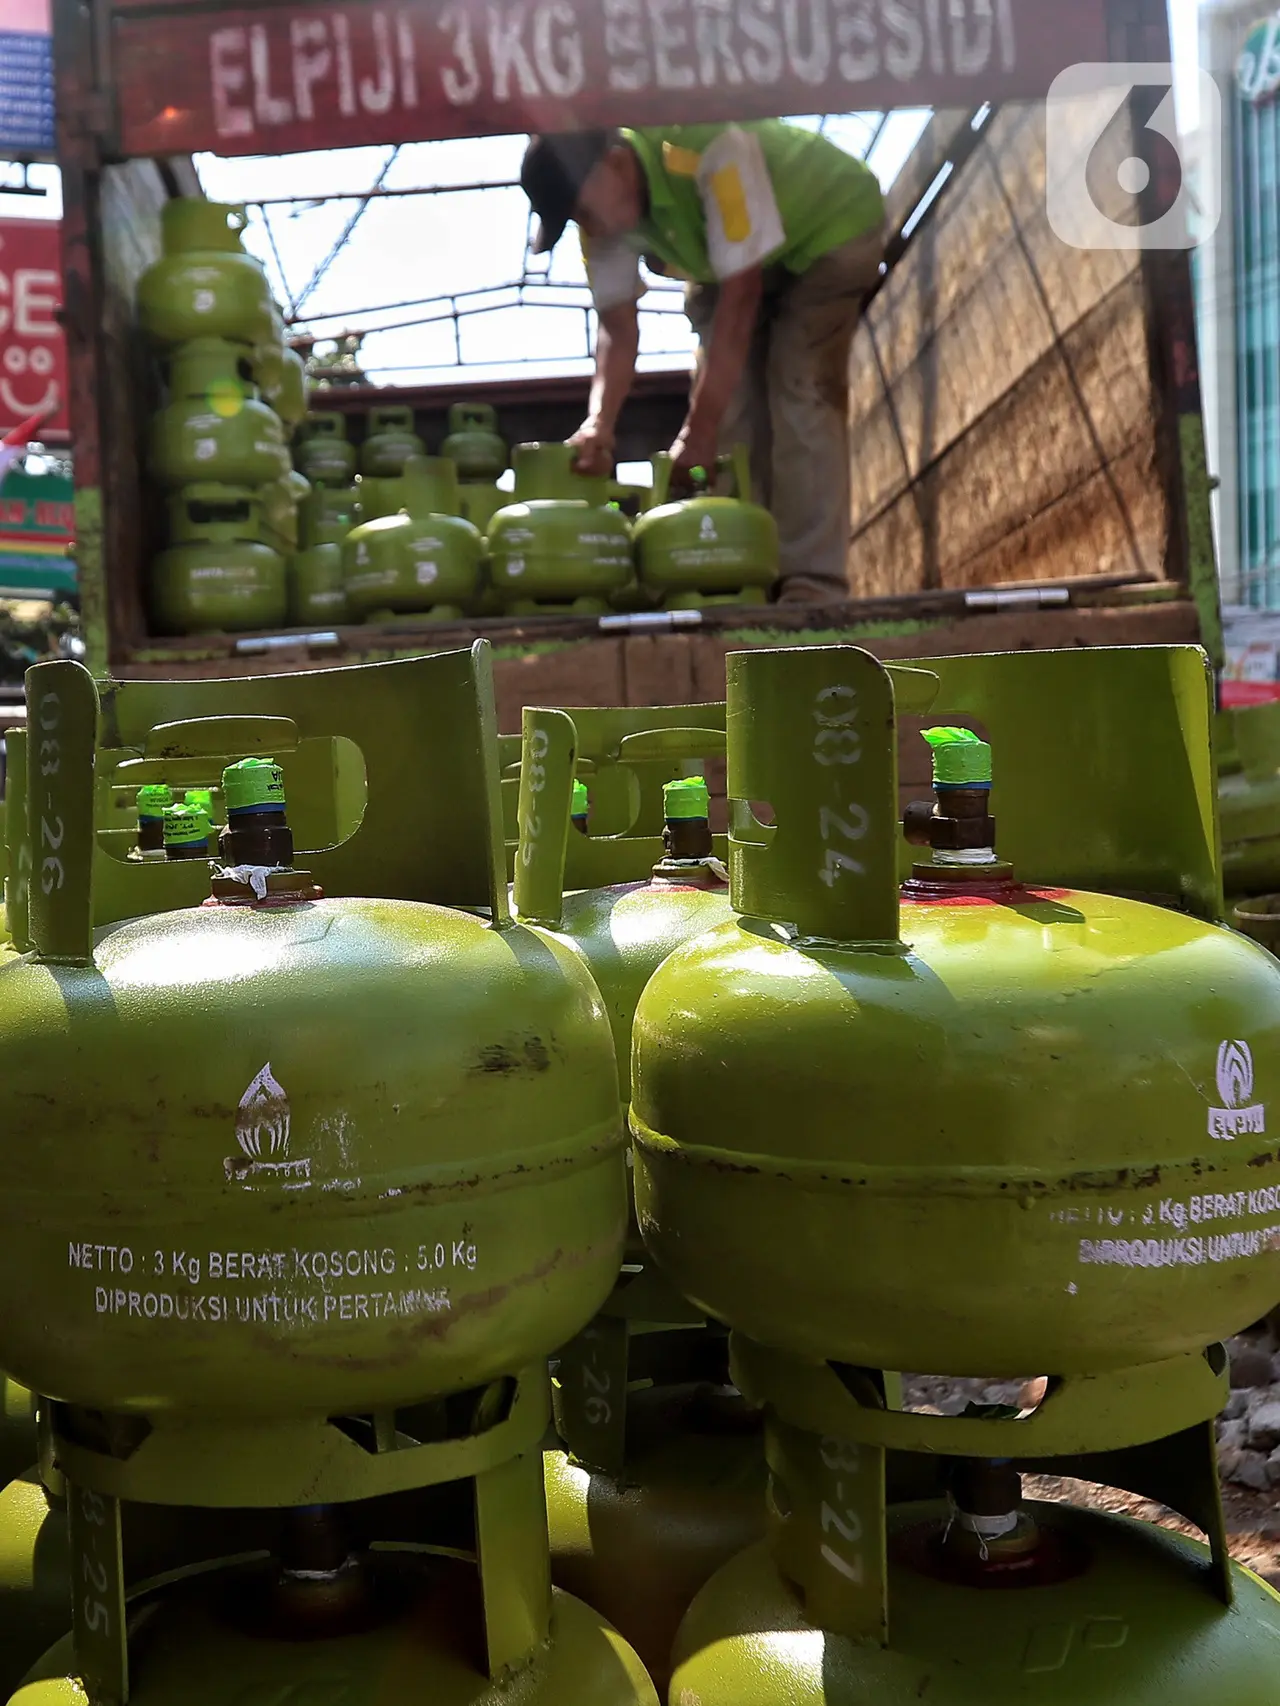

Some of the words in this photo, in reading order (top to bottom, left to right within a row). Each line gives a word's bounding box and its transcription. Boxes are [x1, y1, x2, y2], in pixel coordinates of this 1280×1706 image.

[210, 10, 418, 138] ELPIJI
[0, 266, 59, 338] E
[812, 685, 869, 889] 08-24
[1159, 1198, 1188, 1232] Kg
[1190, 1191, 1246, 1224] BERAT
[68, 1241, 134, 1274] NETTO
[153, 1250, 165, 1275] 3
[172, 1250, 201, 1284] Kg
[208, 1251, 287, 1279] BERAT
[294, 1248, 396, 1279] KOSONG
[452, 1239, 477, 1271] Kg
[95, 1286, 229, 1322] DIPRODUKSI
[235, 1291, 319, 1325] UNTUK
